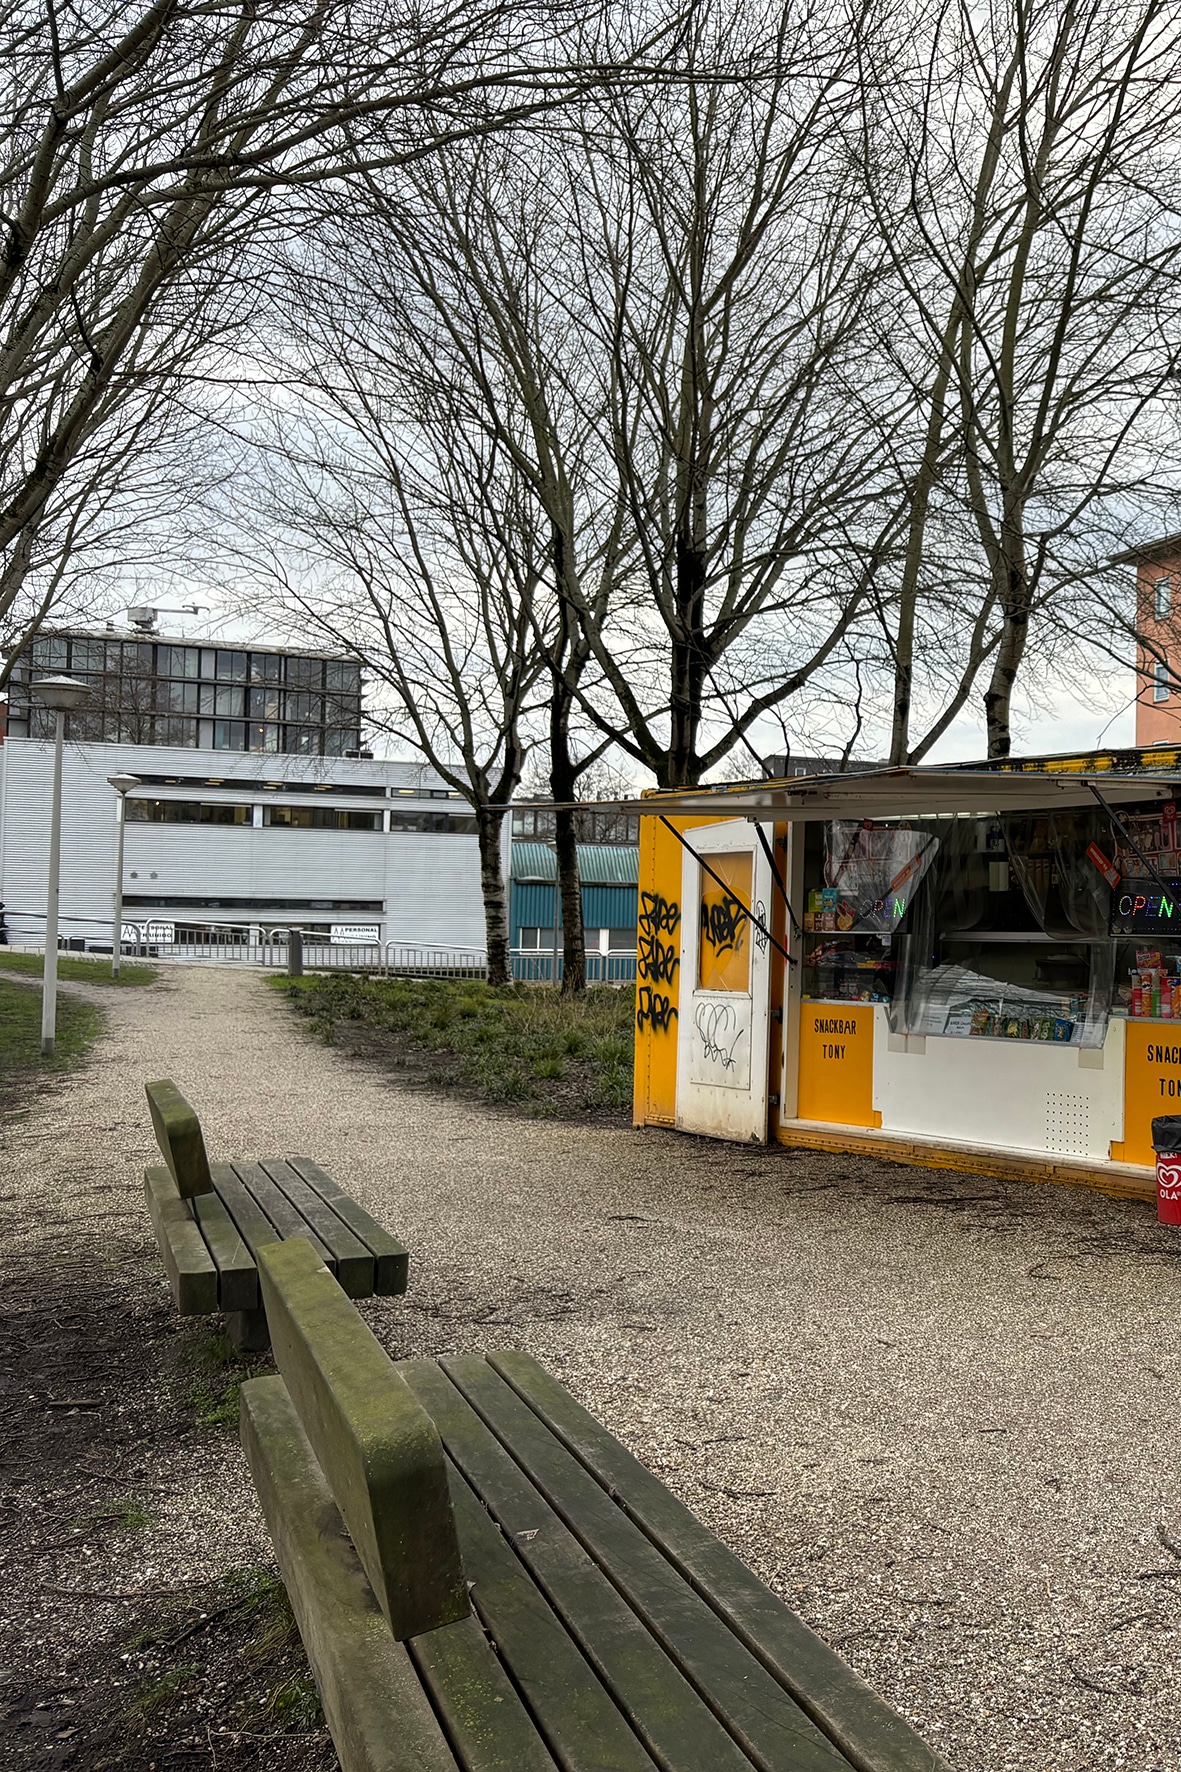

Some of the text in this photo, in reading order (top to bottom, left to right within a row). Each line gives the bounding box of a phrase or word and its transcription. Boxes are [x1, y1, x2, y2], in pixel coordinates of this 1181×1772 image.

[1119, 895, 1173, 918] OPEN
[814, 1018, 857, 1035] SNACKBAR
[822, 1044, 846, 1059] TONY
[1160, 1189, 1179, 1201] OLA
